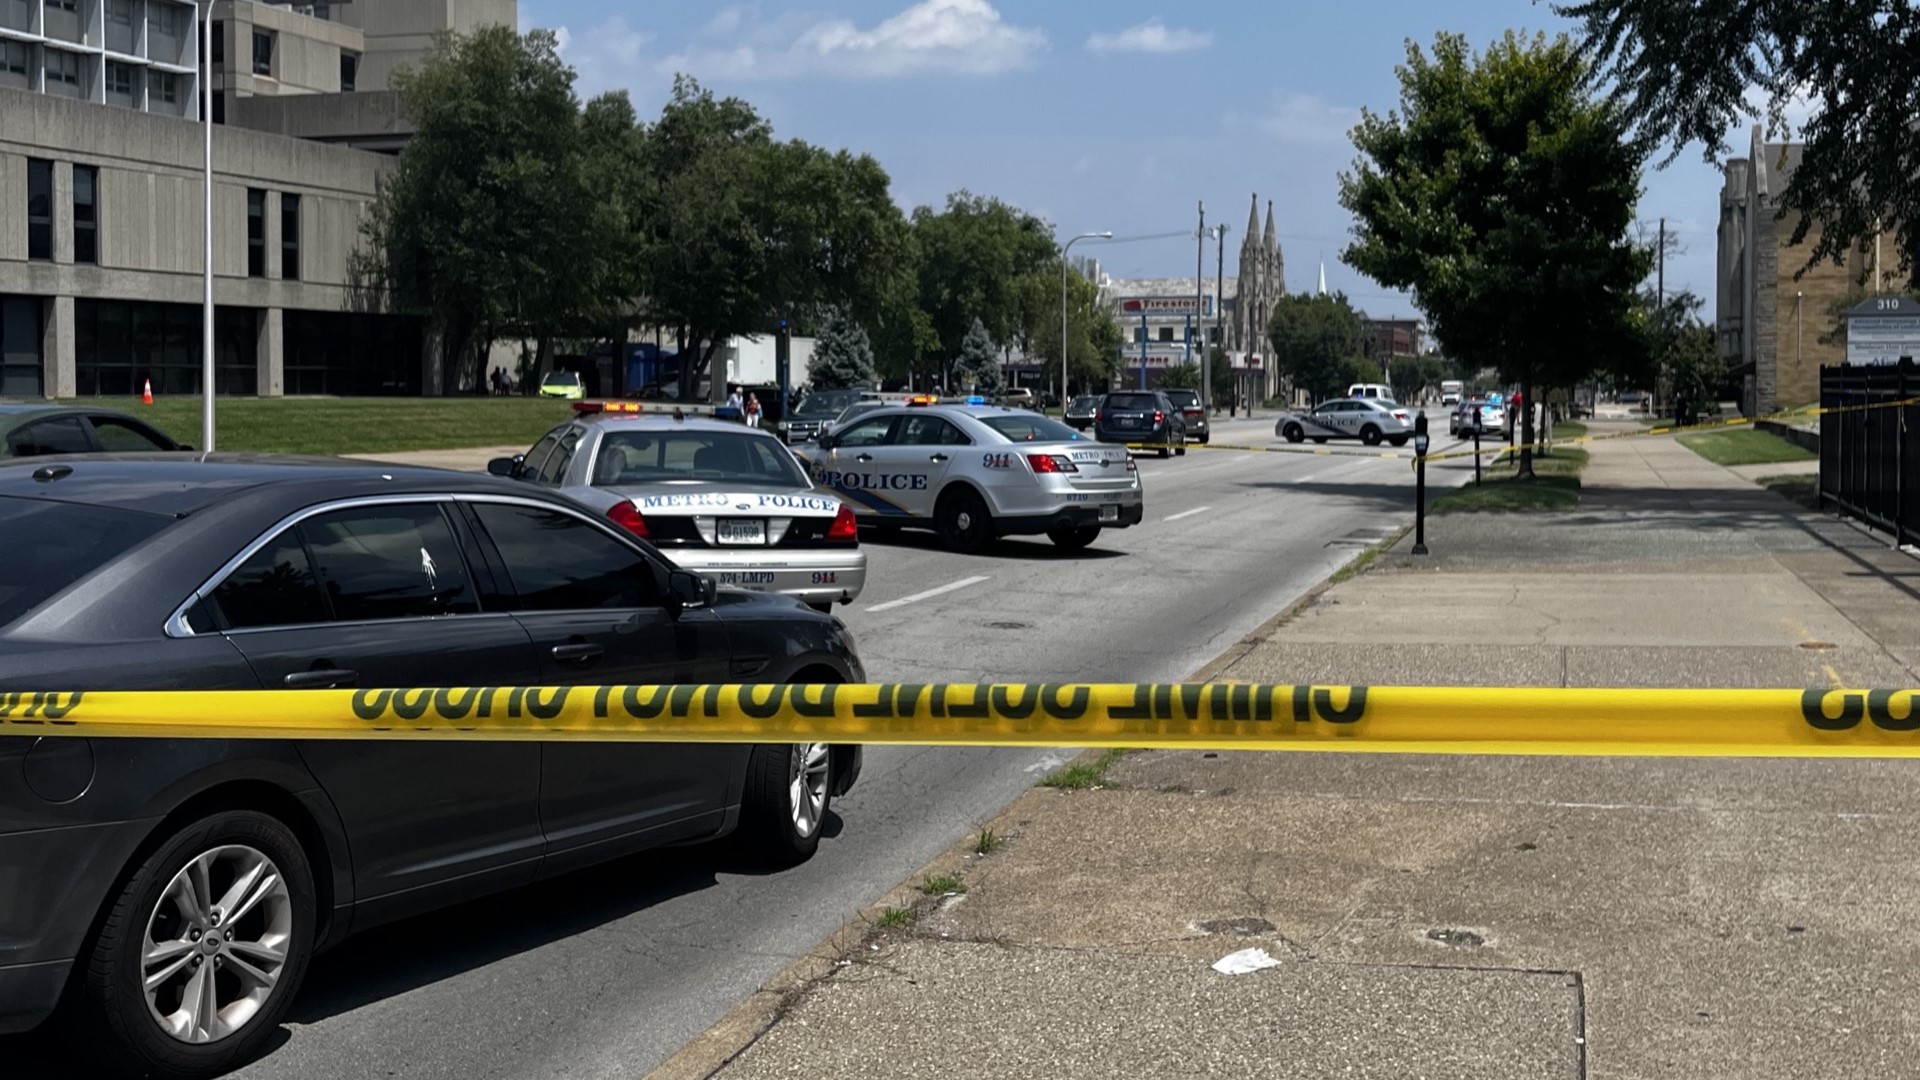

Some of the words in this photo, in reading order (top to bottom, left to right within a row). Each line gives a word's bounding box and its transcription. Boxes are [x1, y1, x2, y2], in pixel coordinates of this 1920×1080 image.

[1877, 298, 1899, 311] 310
[982, 452, 1010, 468] 911
[1071, 450, 1100, 461] METRO
[825, 471, 928, 490] POLICE
[643, 495, 729, 508] METRO
[758, 495, 835, 512] POLICE
[811, 571, 837, 584] 911
